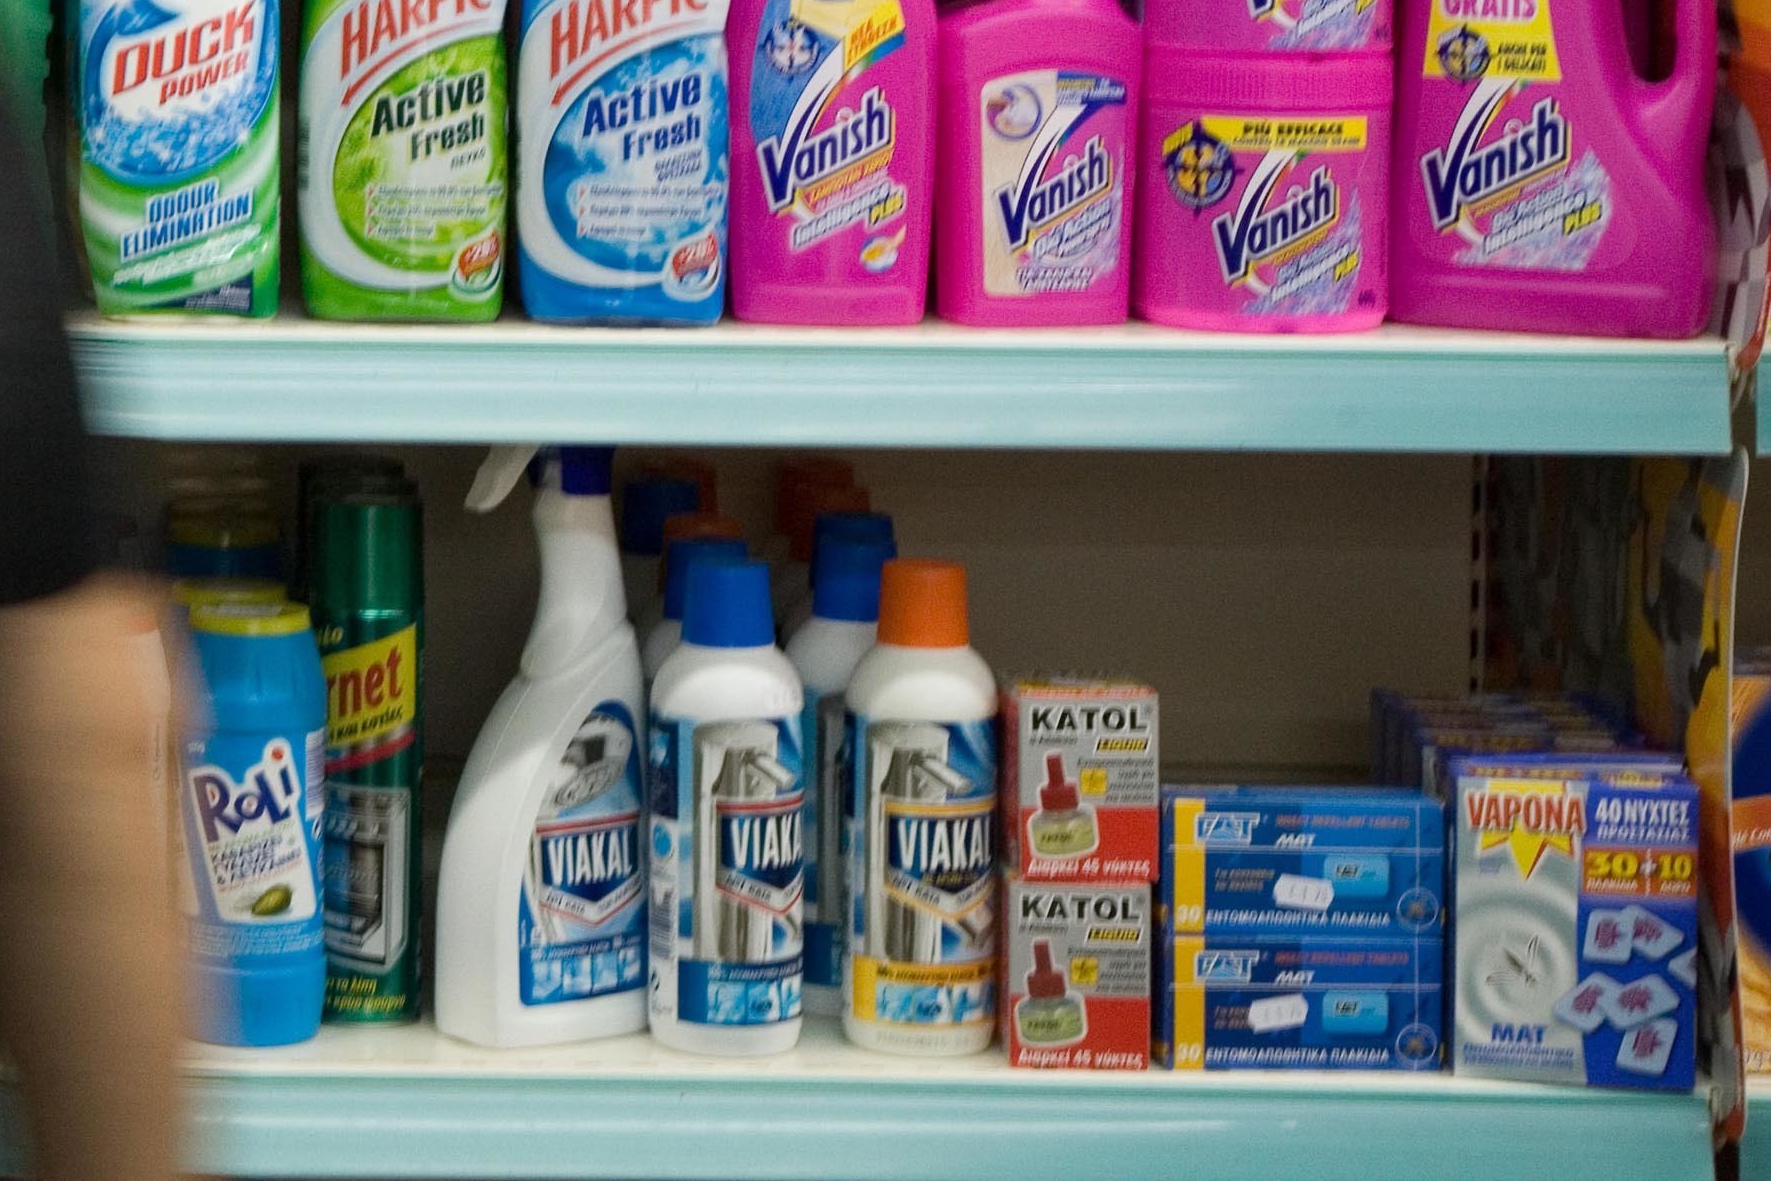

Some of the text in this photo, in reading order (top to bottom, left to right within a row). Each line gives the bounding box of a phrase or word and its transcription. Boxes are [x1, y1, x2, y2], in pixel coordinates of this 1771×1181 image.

[159, 50, 249, 106] POWER
[371, 69, 486, 140] Active
[582, 72, 702, 138] Active
[410, 112, 485, 162] Fresh
[623, 115, 701, 161] Fresh
[759, 81, 890, 206] Vanish
[1426, 88, 1561, 222] Vanish
[998, 132, 1105, 246] Vanish
[121, 190, 253, 258] ELIMINATION
[1217, 159, 1330, 277] Vanish
[327, 644, 403, 718] net
[1031, 705, 1148, 732] KATOL
[1465, 790, 1585, 832] VAPONA
[1596, 796, 1690, 825] 40 ΝΥΧΤΕΣ
[548, 829, 634, 887] VIAKAL
[730, 812, 802, 870] VIAKA
[897, 818, 992, 872] VIAKAL
[1275, 832, 1317, 850] MAT
[1021, 894, 1140, 921] KATOL
[1331, 911, 1392, 928] ΠΛΑΚΙΔΙΑ
[1274, 970, 1316, 986] MAT
[1331, 1047, 1391, 1064] ΠΛΑΚΙΔΙΑ
[1491, 1023, 1546, 1043] MAT
